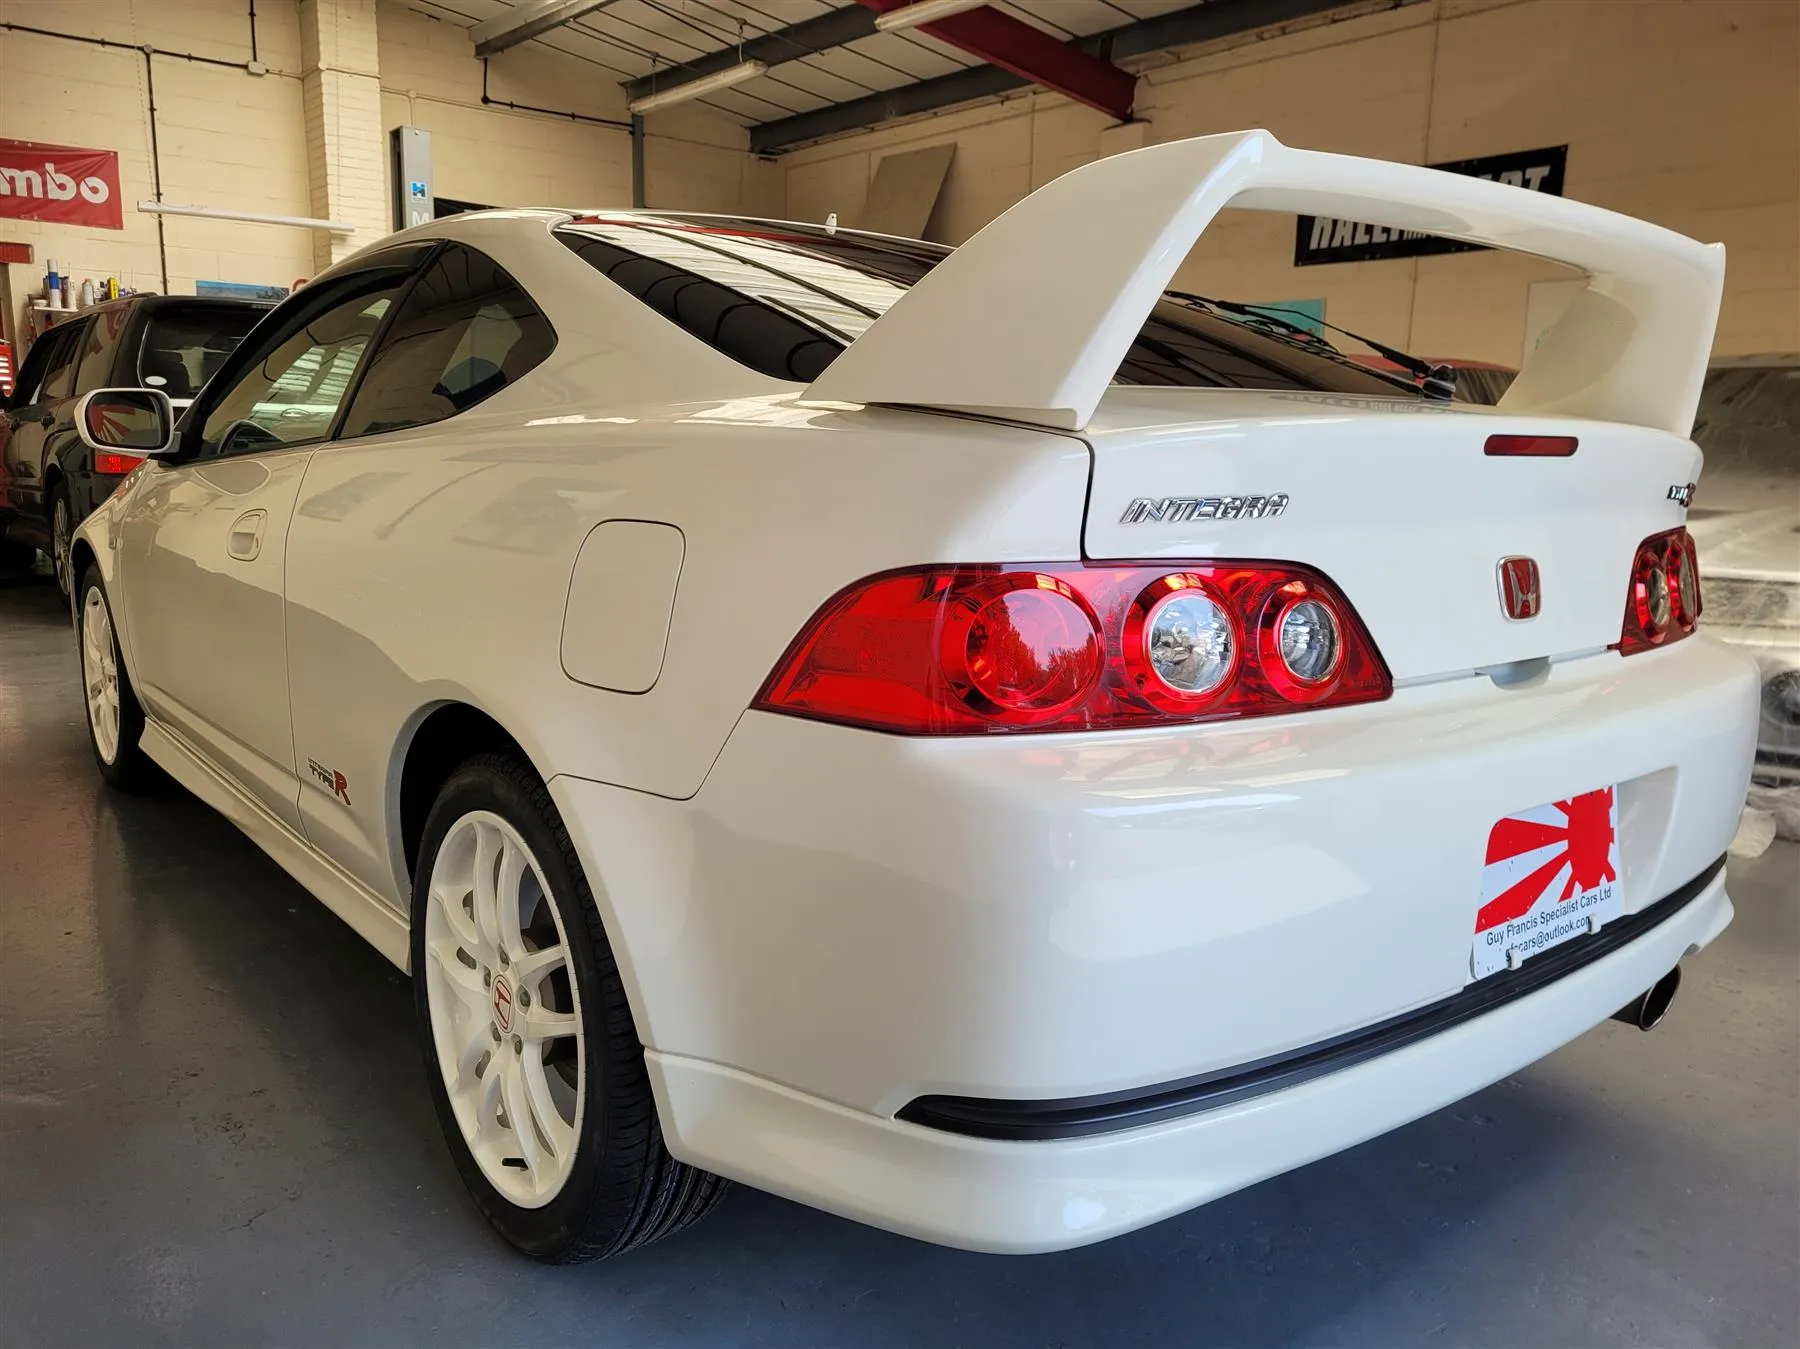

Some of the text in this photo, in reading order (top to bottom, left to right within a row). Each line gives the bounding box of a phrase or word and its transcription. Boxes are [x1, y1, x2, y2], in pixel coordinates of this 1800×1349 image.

[1309, 215, 1400, 251] RALL
[1118, 492, 1290, 525] INTEGRA
[333, 768, 352, 806] R
[1486, 886, 1612, 947] Guy Francis Specialist Cars Ltd
